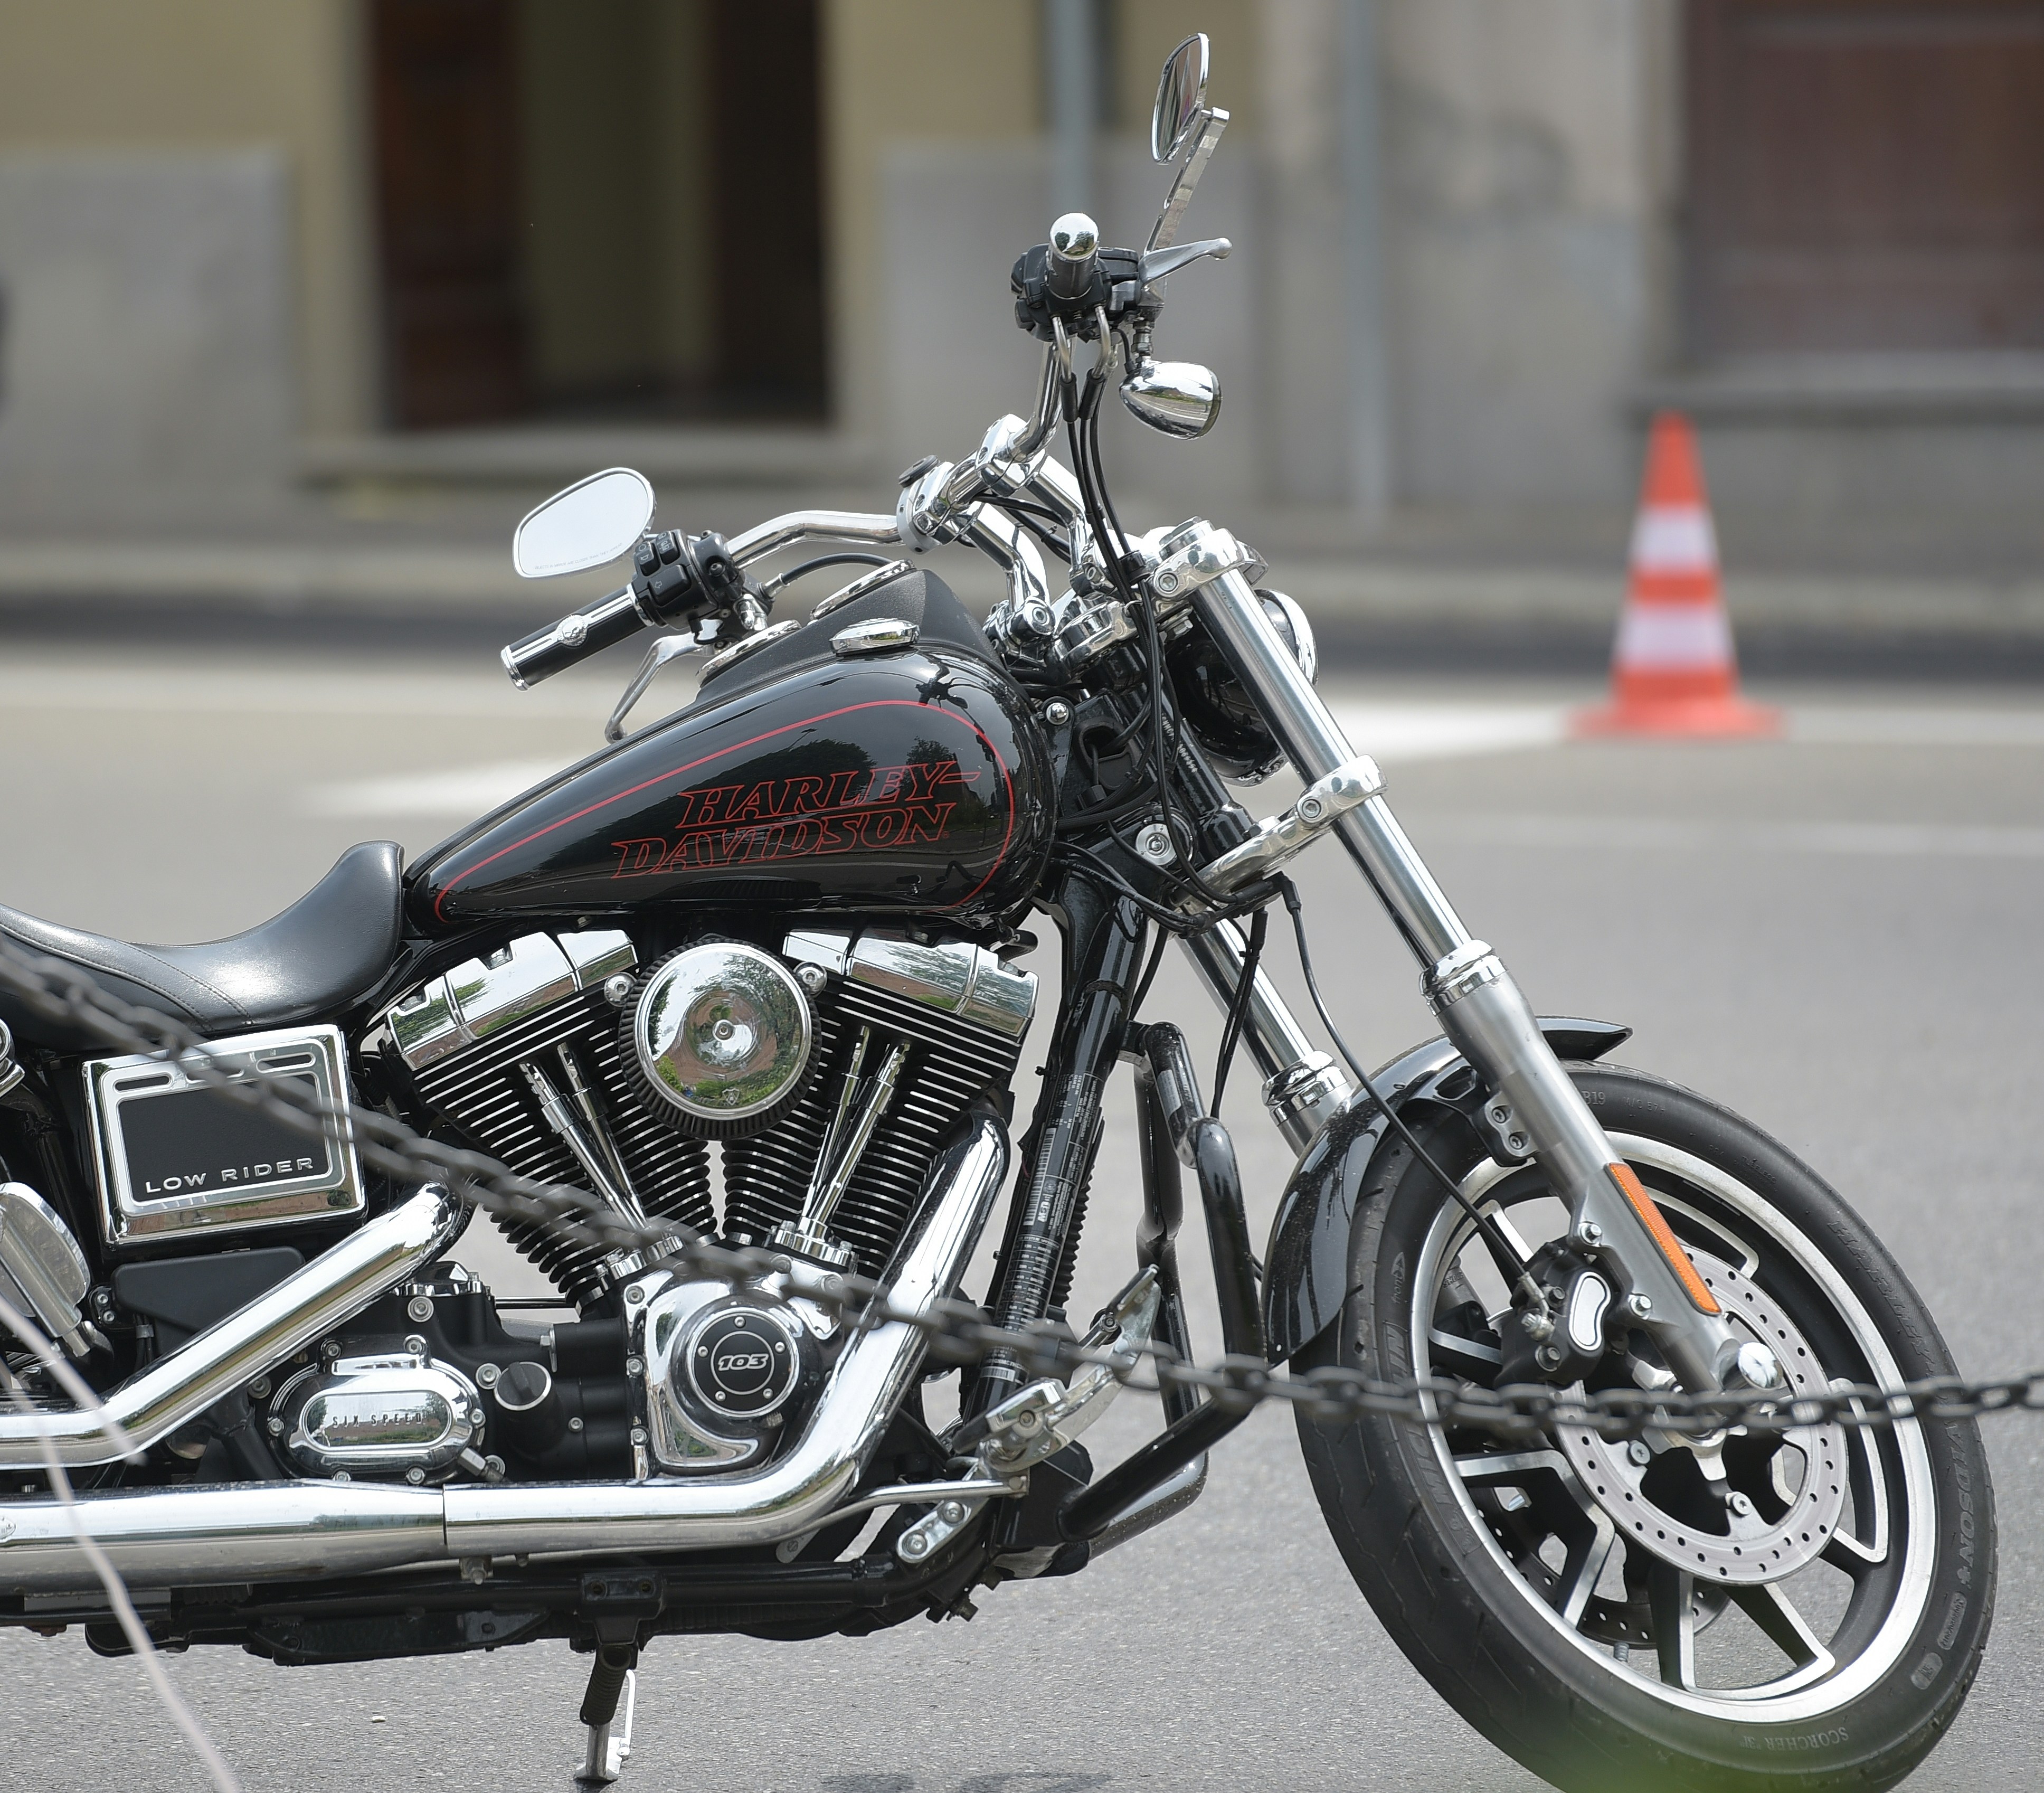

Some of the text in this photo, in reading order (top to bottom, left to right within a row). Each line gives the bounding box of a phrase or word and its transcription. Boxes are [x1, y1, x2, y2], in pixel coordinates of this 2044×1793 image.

[610, 803, 957, 879] DAVIDSON
[145, 1157, 314, 1194] LOW RIDER
[717, 1353, 769, 1371] 103
[332, 1412, 423, 1428] SIX SPEED
[1386, 1324, 1453, 1505] MICLIN
[1764, 1726, 1849, 1751] SCORCHER
